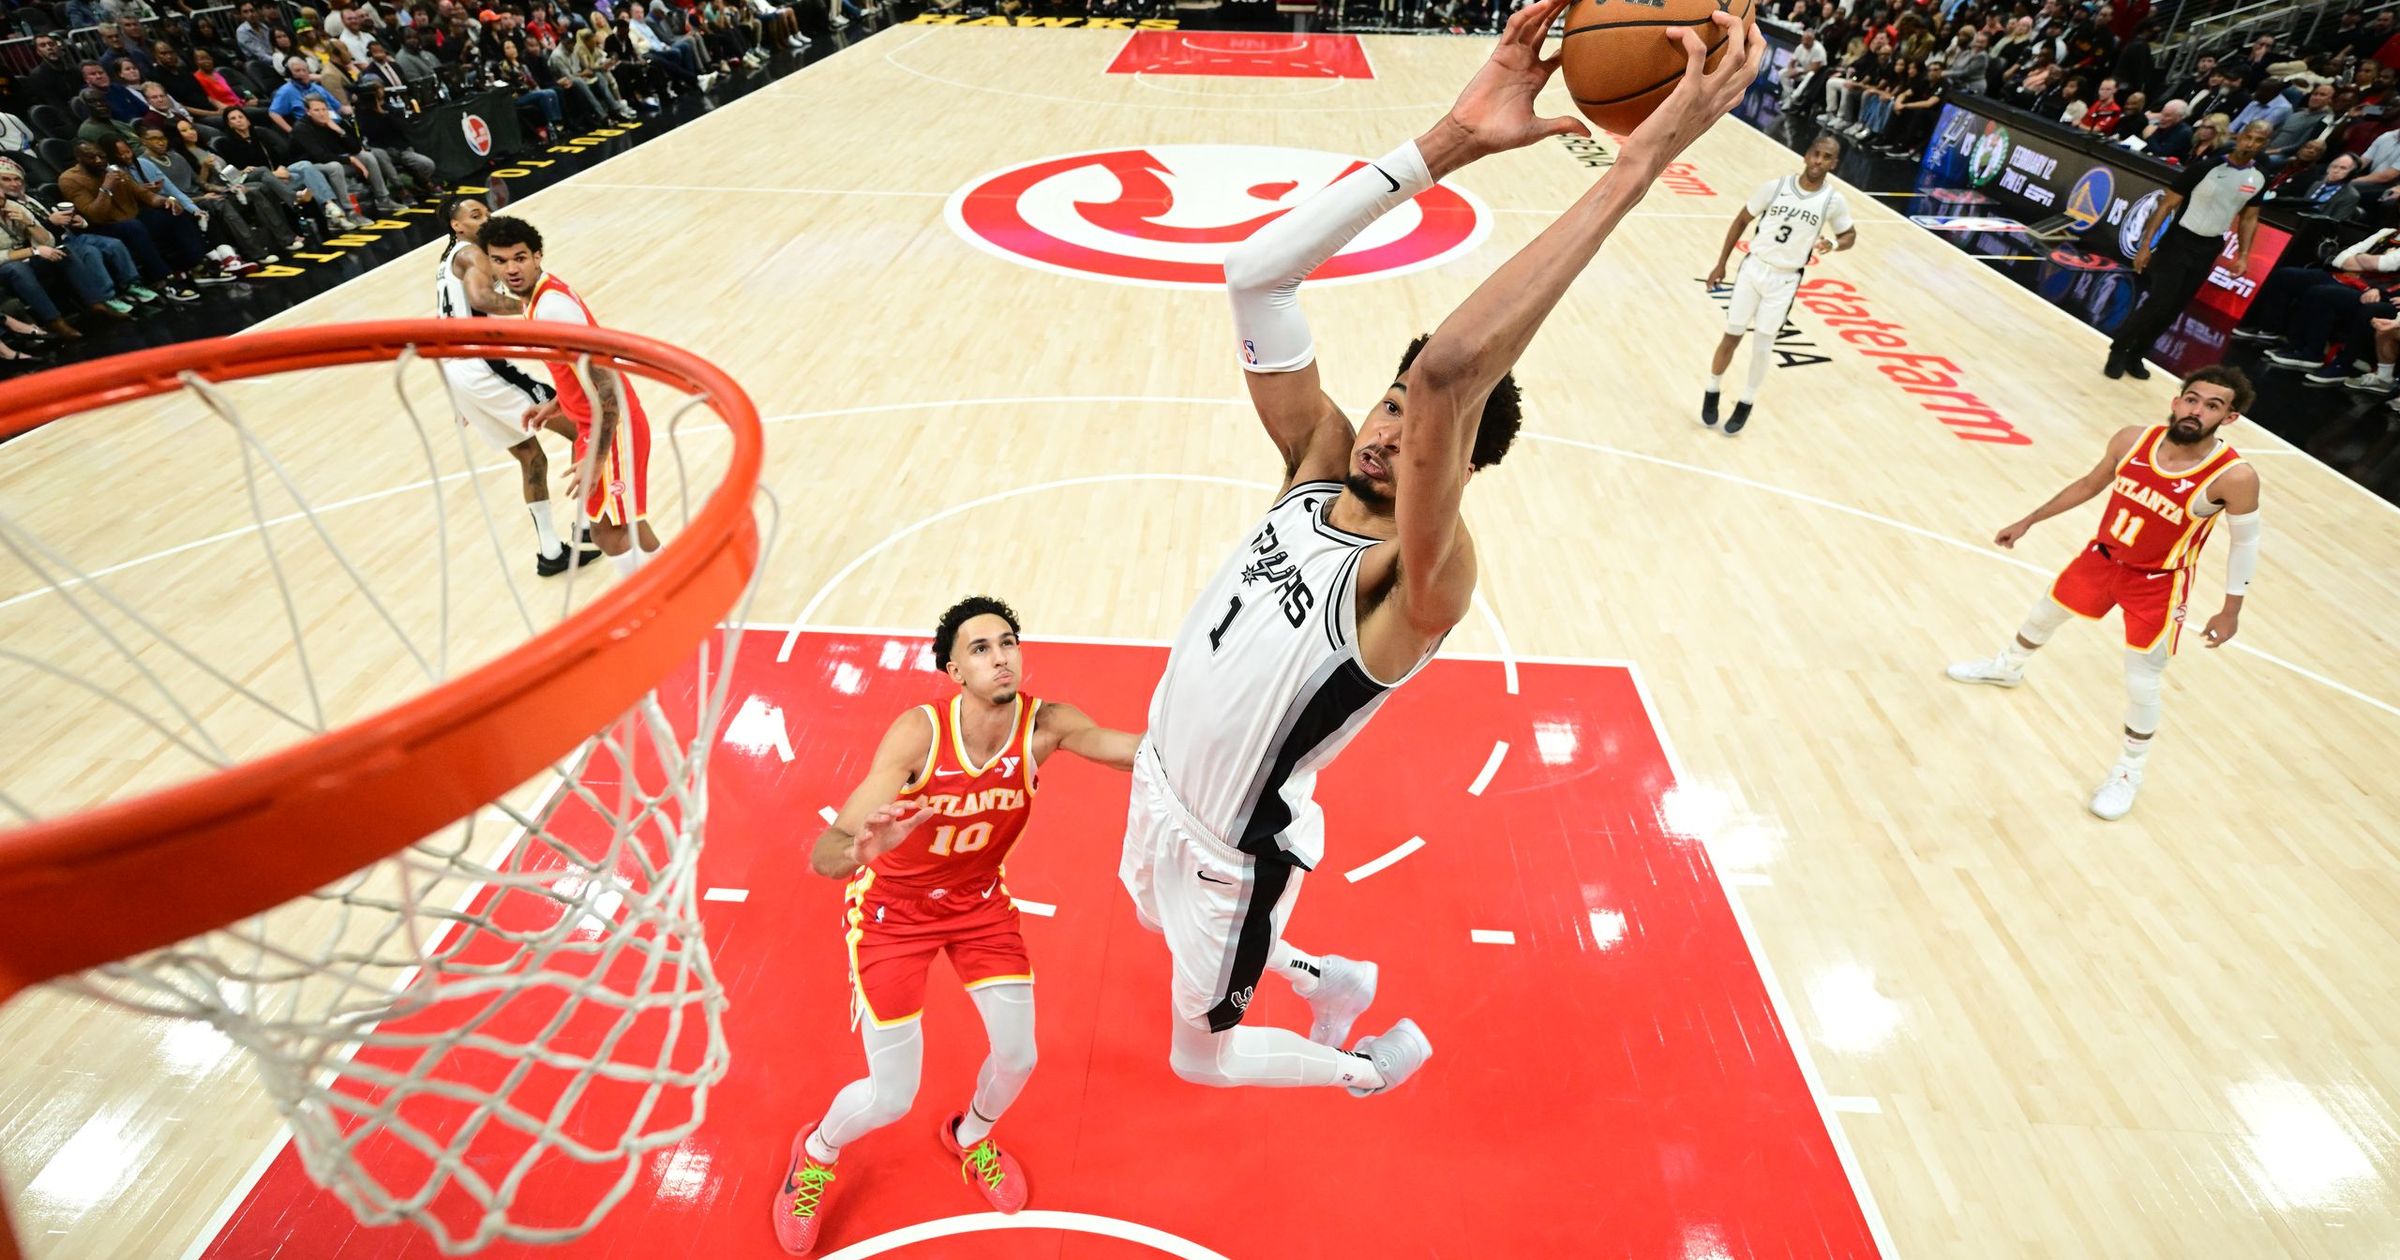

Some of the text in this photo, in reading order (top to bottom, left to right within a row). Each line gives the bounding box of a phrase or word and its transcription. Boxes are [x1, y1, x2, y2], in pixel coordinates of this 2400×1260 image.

[901, 14, 1180, 30] HAWKS
[546, 121, 643, 154] TRUE
[490, 158, 556, 179] TO
[2023, 182, 2056, 207] ESPN
[1769, 205, 1820, 226] SPURS
[2107, 197, 2129, 226] VS
[246, 185, 490, 278] ALANTA
[1774, 225, 1793, 244] 3
[2208, 265, 2257, 298] ESPN
[2108, 507, 2145, 548] 11
[1207, 592, 1246, 658] 1
[928, 821, 994, 857] 10
